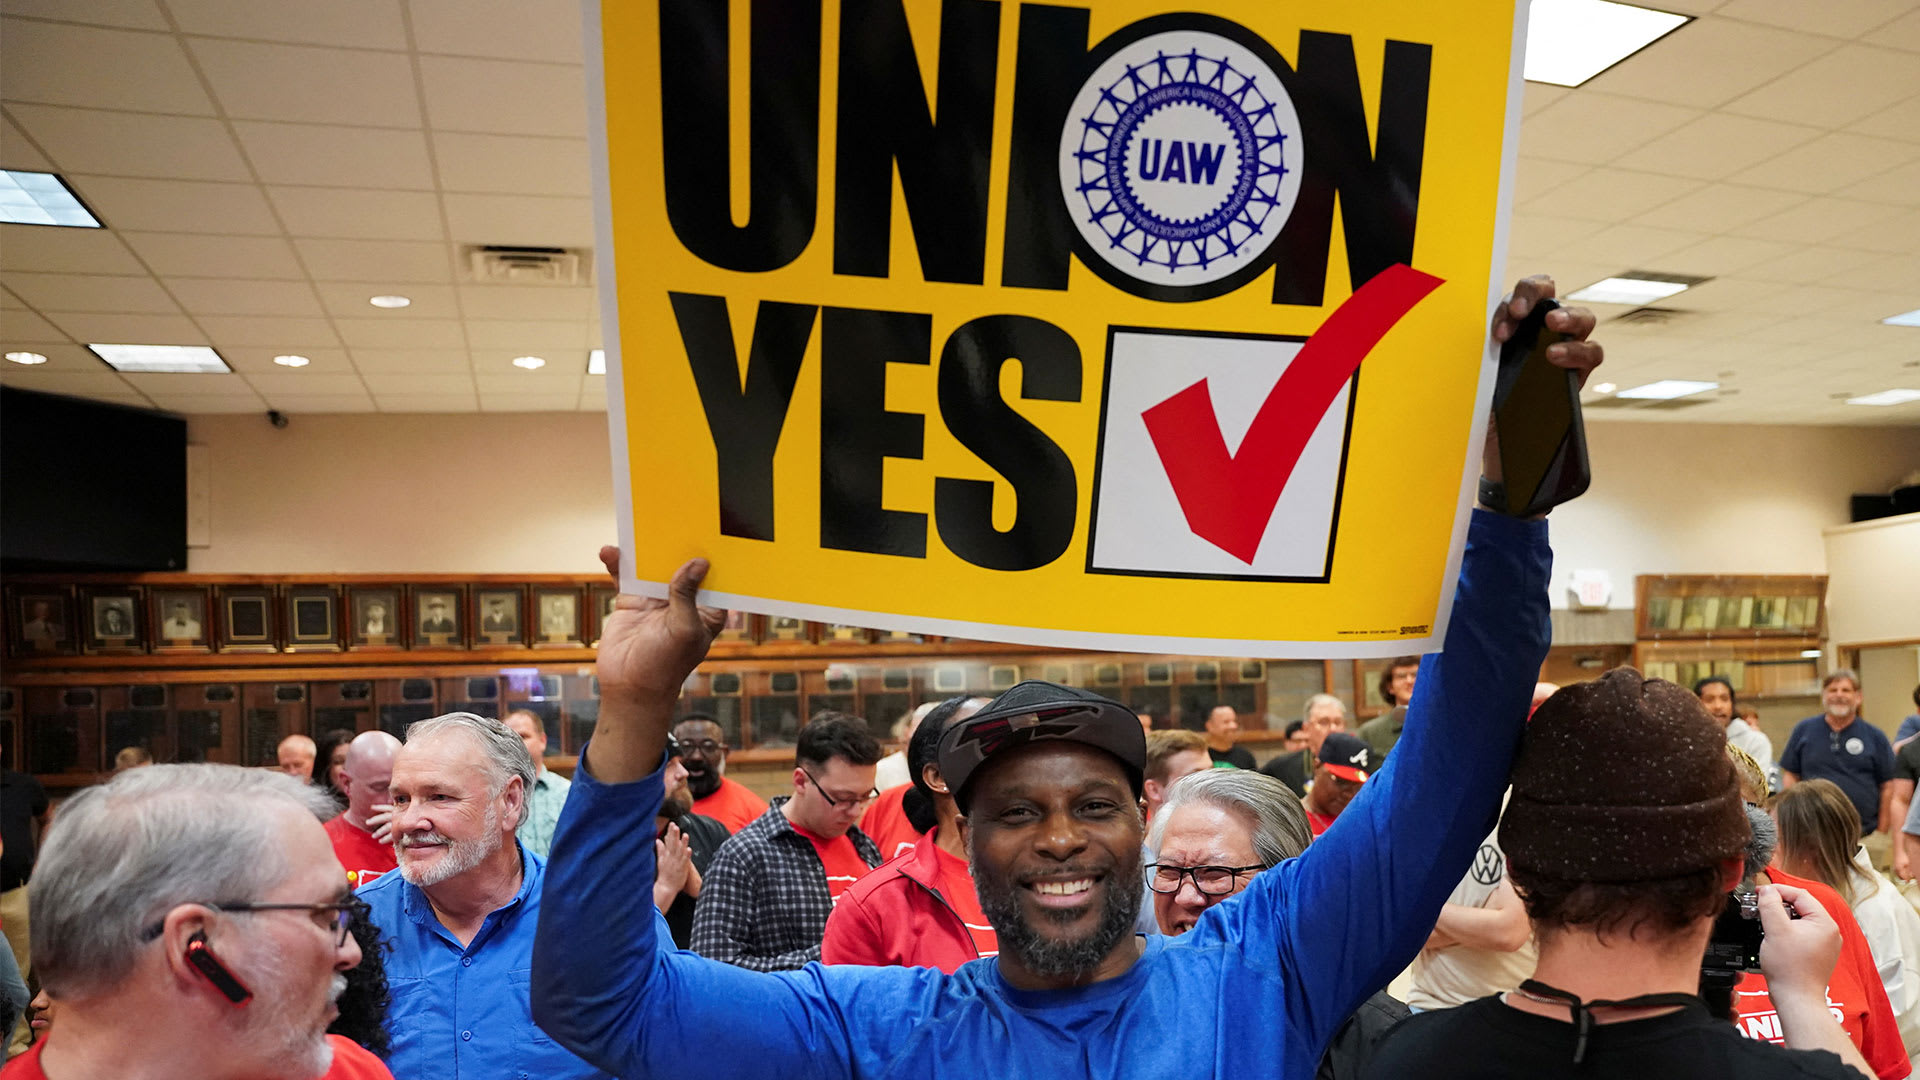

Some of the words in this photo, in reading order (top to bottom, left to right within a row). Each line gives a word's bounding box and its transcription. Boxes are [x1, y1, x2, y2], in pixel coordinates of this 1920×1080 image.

[659, 0, 1433, 306] UNION
[1139, 138, 1226, 185] UAW
[668, 290, 1083, 571] YES
